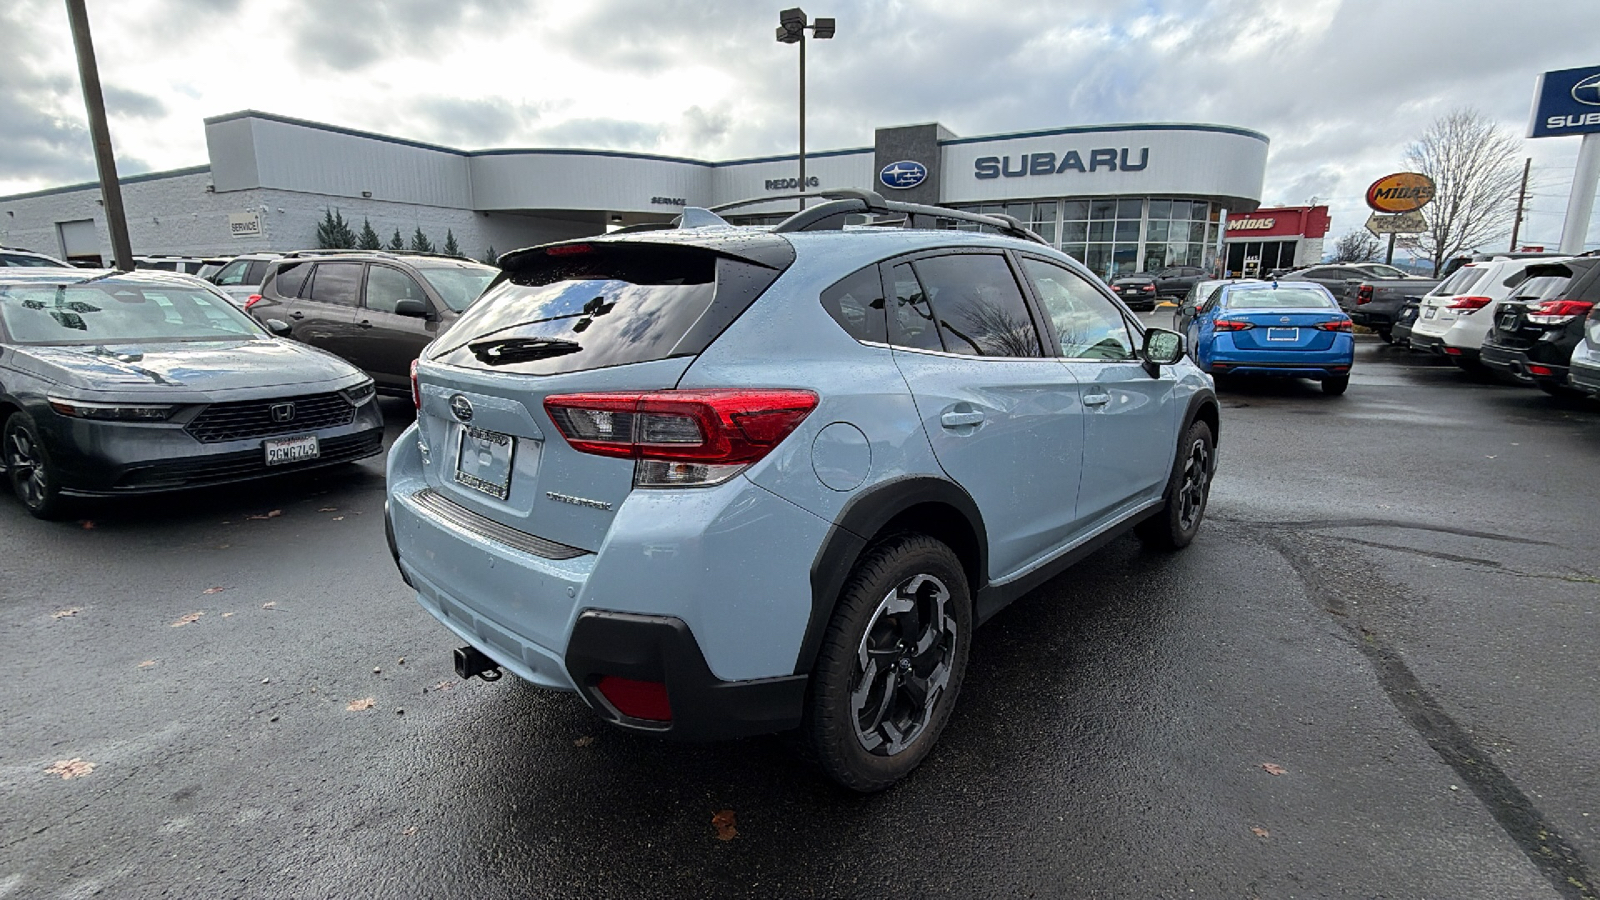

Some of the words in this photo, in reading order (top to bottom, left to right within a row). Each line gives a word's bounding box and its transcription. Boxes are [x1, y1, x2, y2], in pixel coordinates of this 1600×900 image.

[974, 147, 1149, 180] SUBARU
[651, 196, 687, 206] SERVICE
[231, 221, 257, 232] SERVICE
